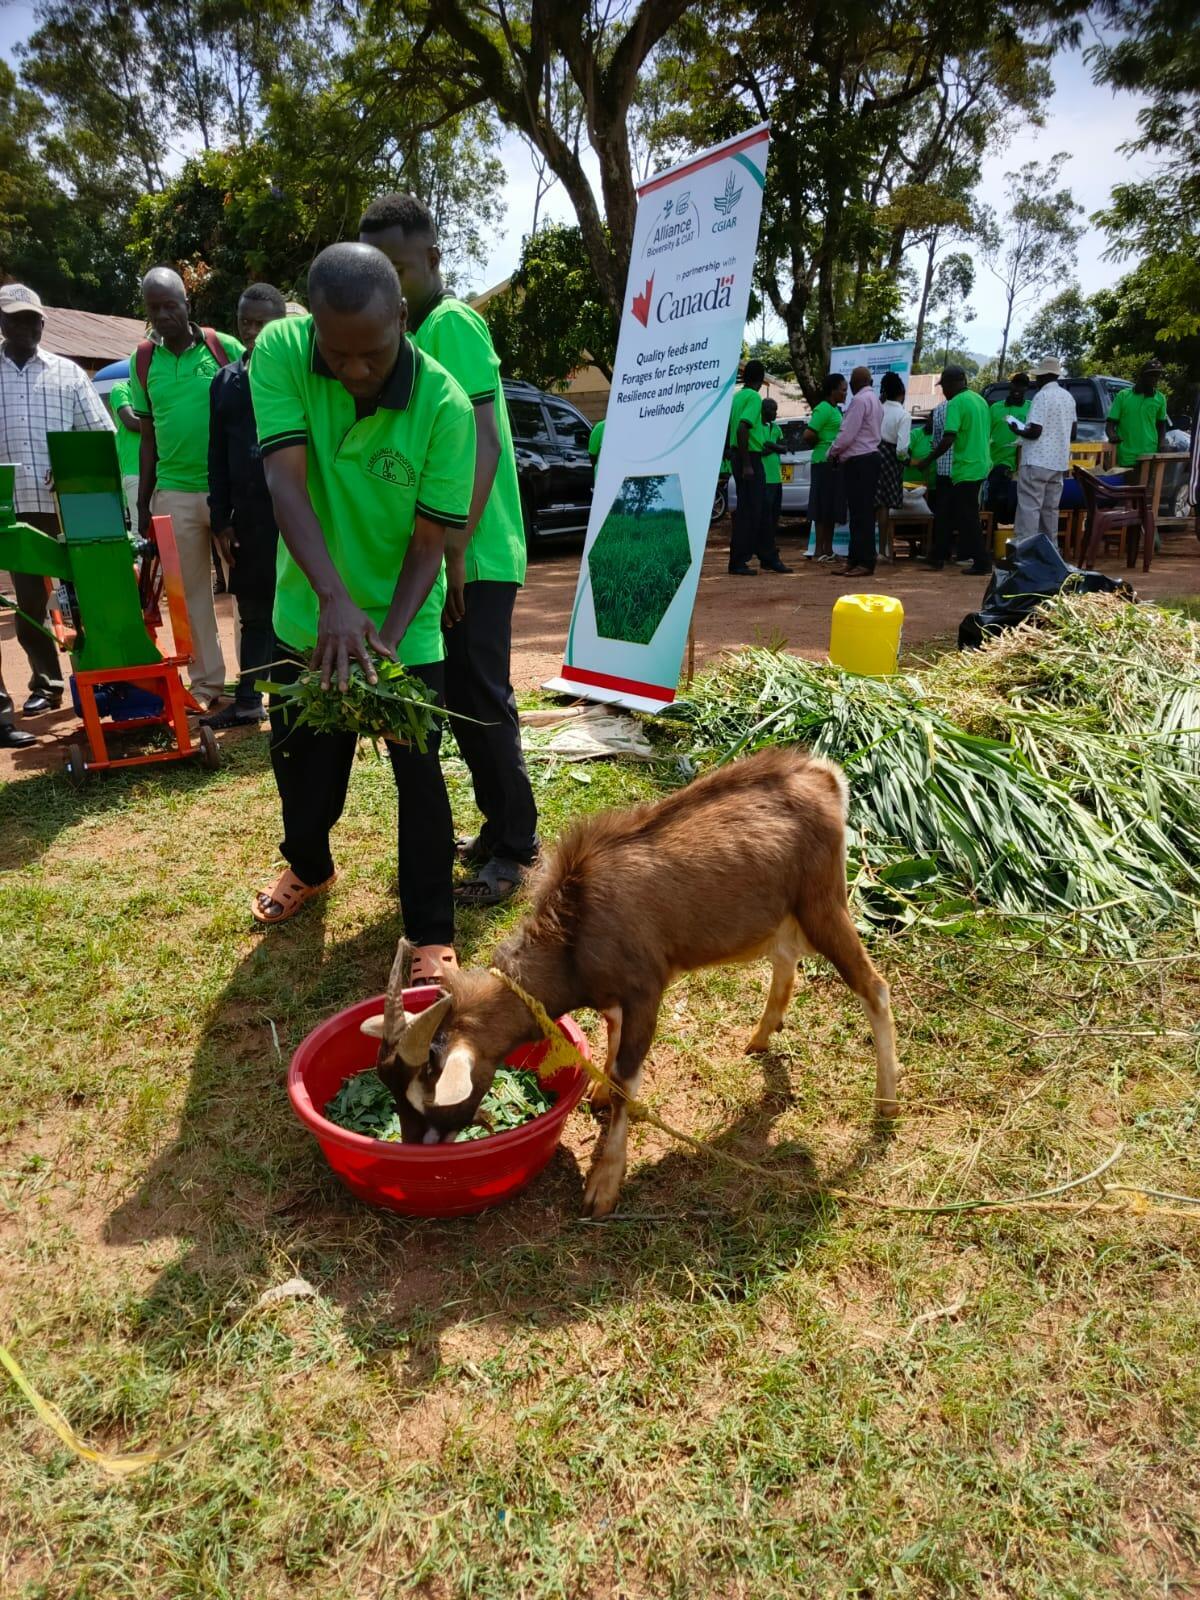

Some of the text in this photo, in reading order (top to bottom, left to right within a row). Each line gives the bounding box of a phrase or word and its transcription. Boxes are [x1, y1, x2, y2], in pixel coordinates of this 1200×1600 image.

[653, 218, 692, 244] Alliance
[711, 217, 737, 234] CGIAR
[675, 236, 681, 248] &
[680, 231, 695, 245] CIAT
[681, 260, 721, 281] partnership
[722, 256, 737, 267] with
[656, 277, 732, 324] Canada
[636, 337, 709, 366] Quality feeds and
[621, 359, 720, 386] Forages for Eco-system
[616, 376, 720, 404] Resilience and Improved
[639, 401, 686, 419] Livelihoods
